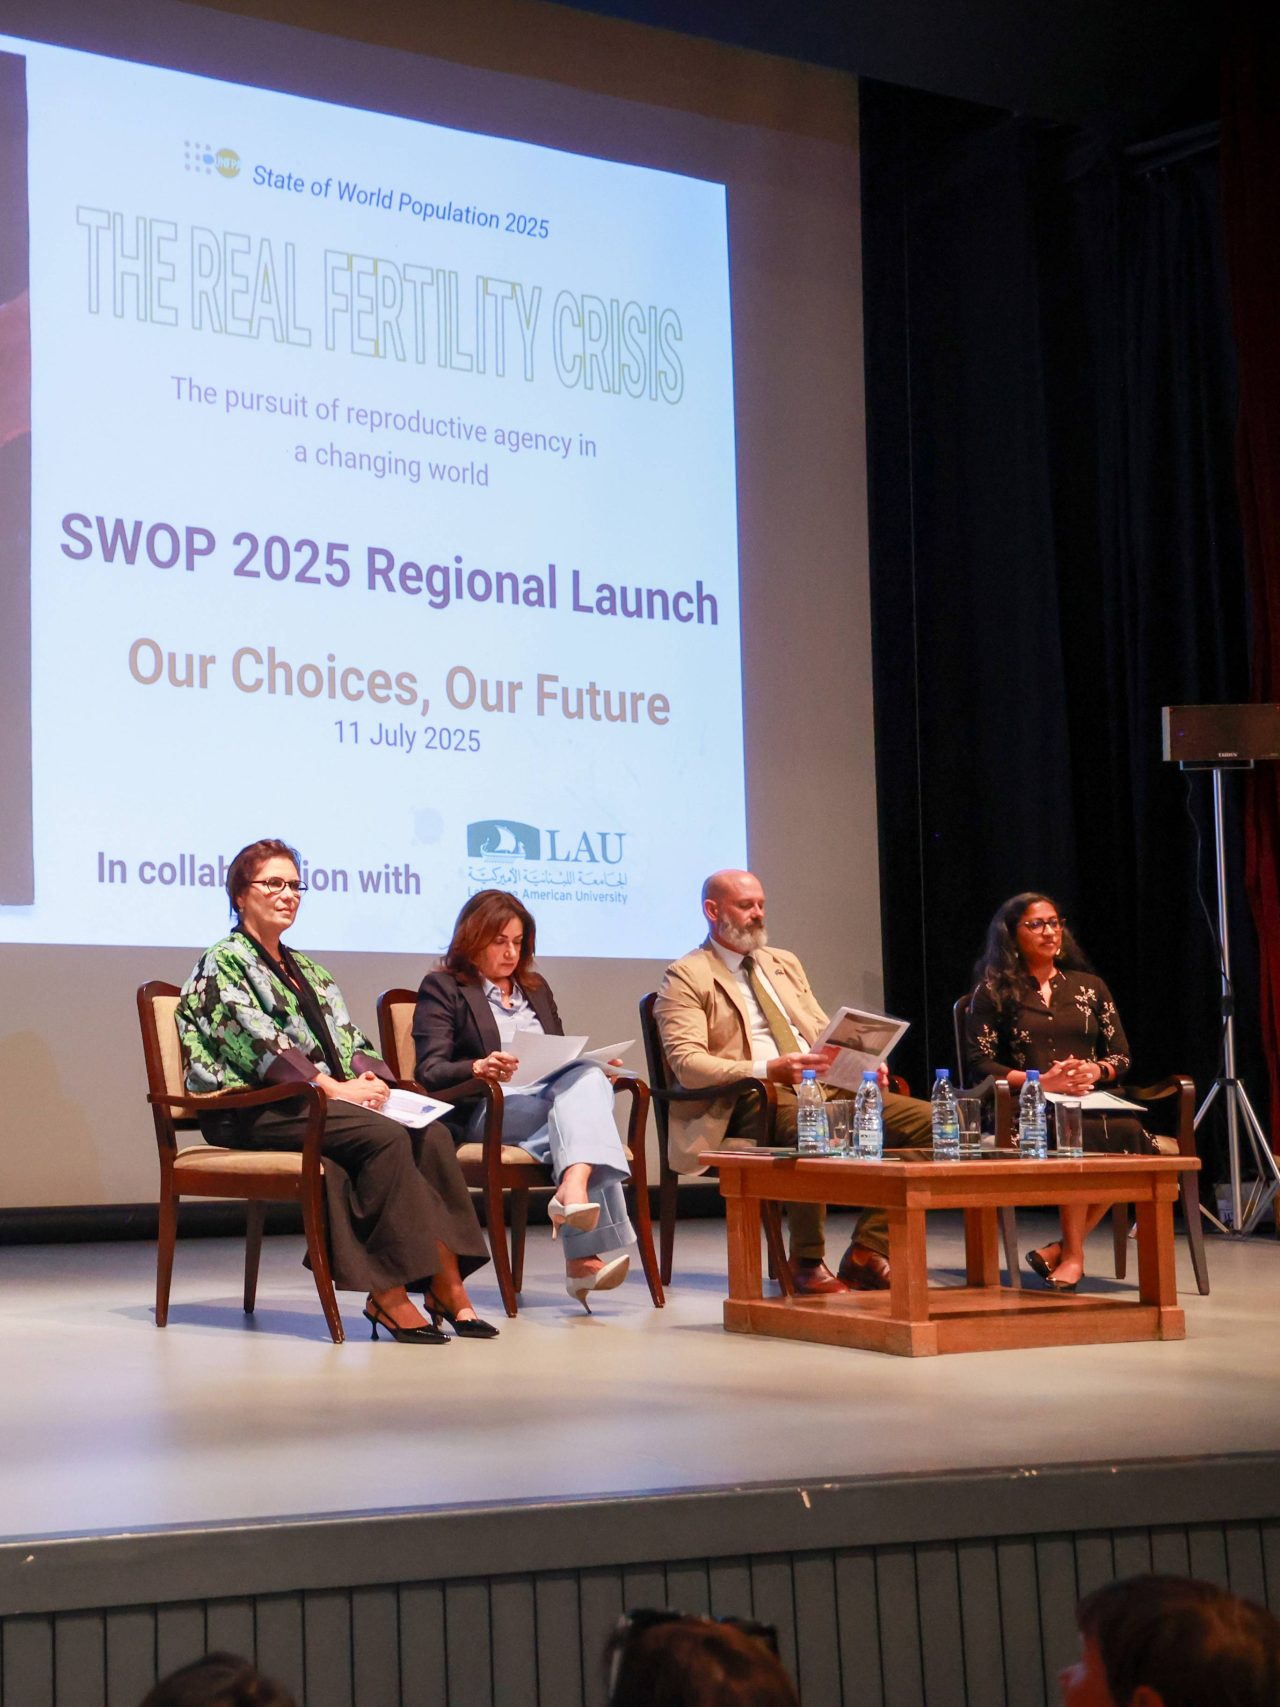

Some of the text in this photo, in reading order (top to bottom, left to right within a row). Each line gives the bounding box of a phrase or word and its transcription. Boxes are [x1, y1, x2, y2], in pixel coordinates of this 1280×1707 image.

[253, 165, 550, 239] State of World Population 2025
[76, 205, 684, 405] THE REAL FERTILITY CRISIS
[171, 376, 597, 457] The pursuit of reproductive agency in
[294, 442, 489, 487] a changing world
[60, 513, 718, 625] SWOP 2025 Regional Launch
[129, 638, 671, 725] Our Choices, Our Future
[334, 721, 481, 755] 11 July 2025
[97, 851, 421, 895] In collabion with
[546, 829, 626, 864] LAU
[523, 888, 572, 901] American
[575, 890, 628, 904] University
